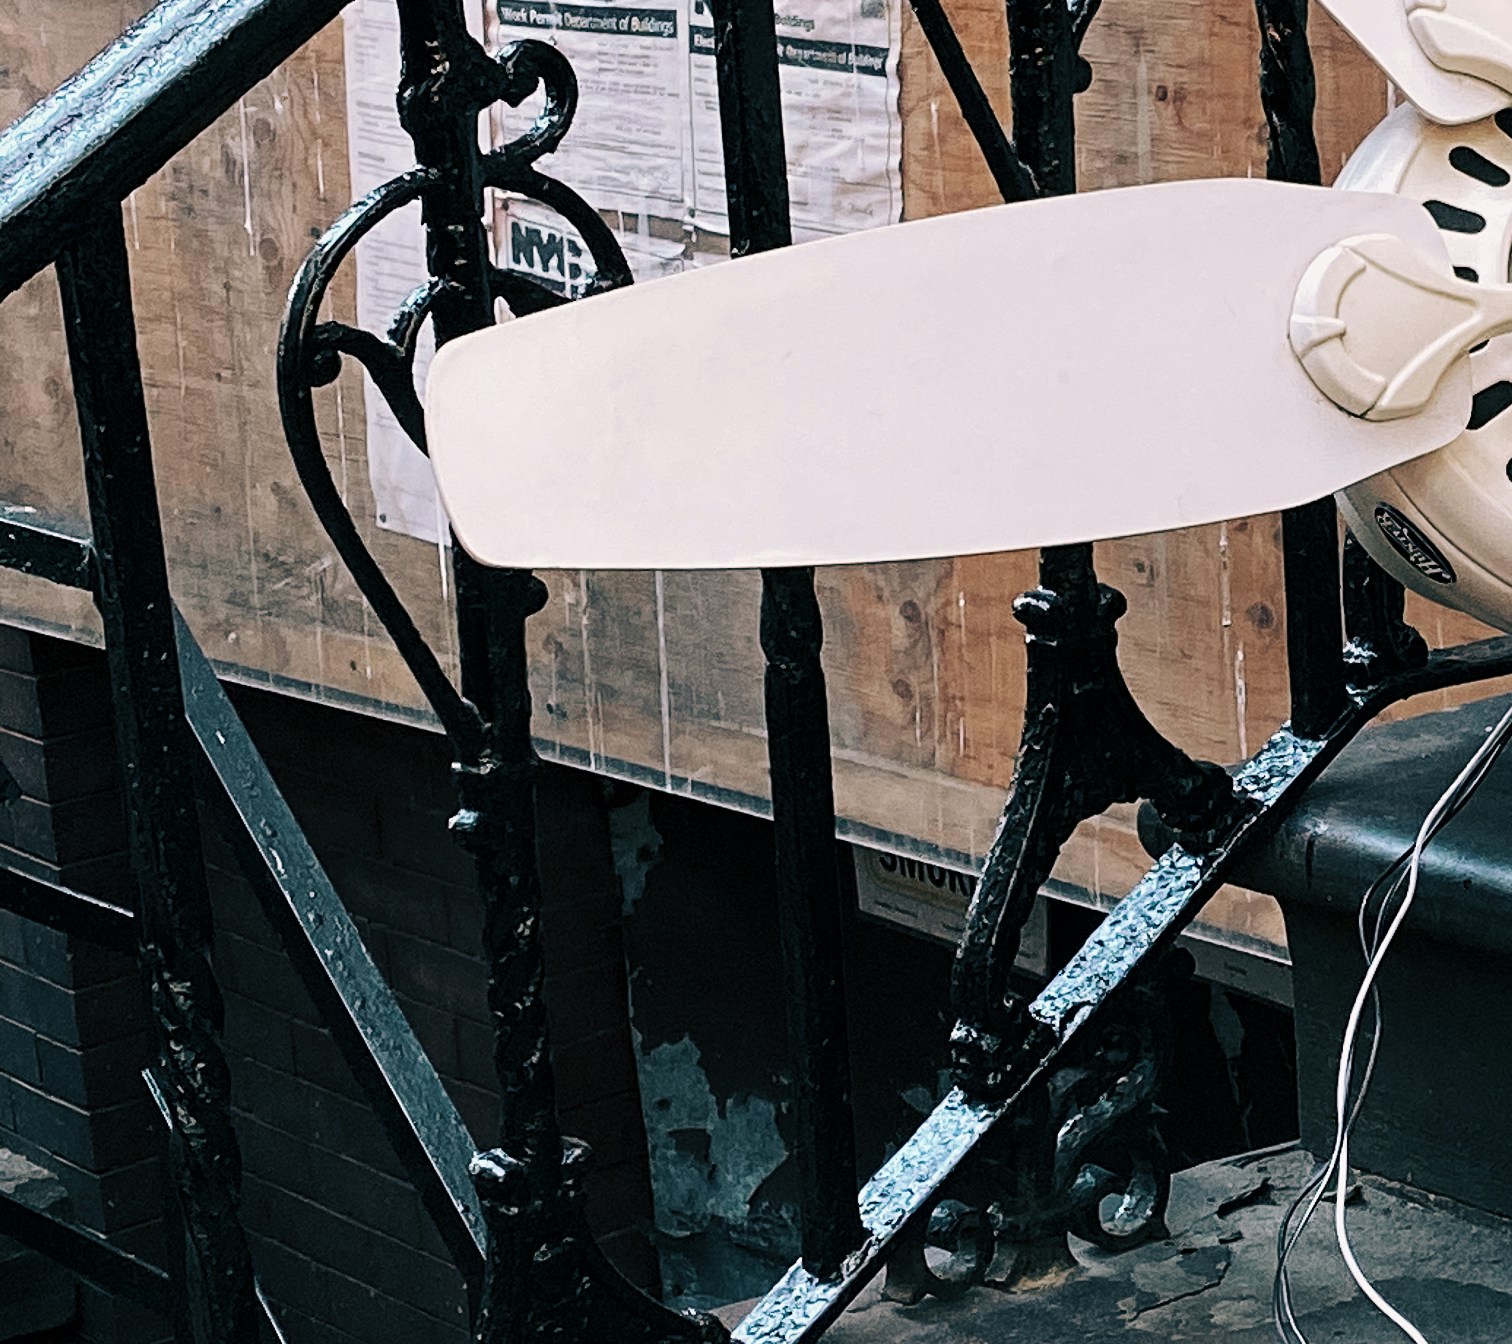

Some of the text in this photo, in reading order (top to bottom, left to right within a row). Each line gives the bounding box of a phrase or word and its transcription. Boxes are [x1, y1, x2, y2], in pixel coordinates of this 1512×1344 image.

[501, 6, 675, 37] Work Permit Department of Buildings
[511, 221, 582, 281] NYC
